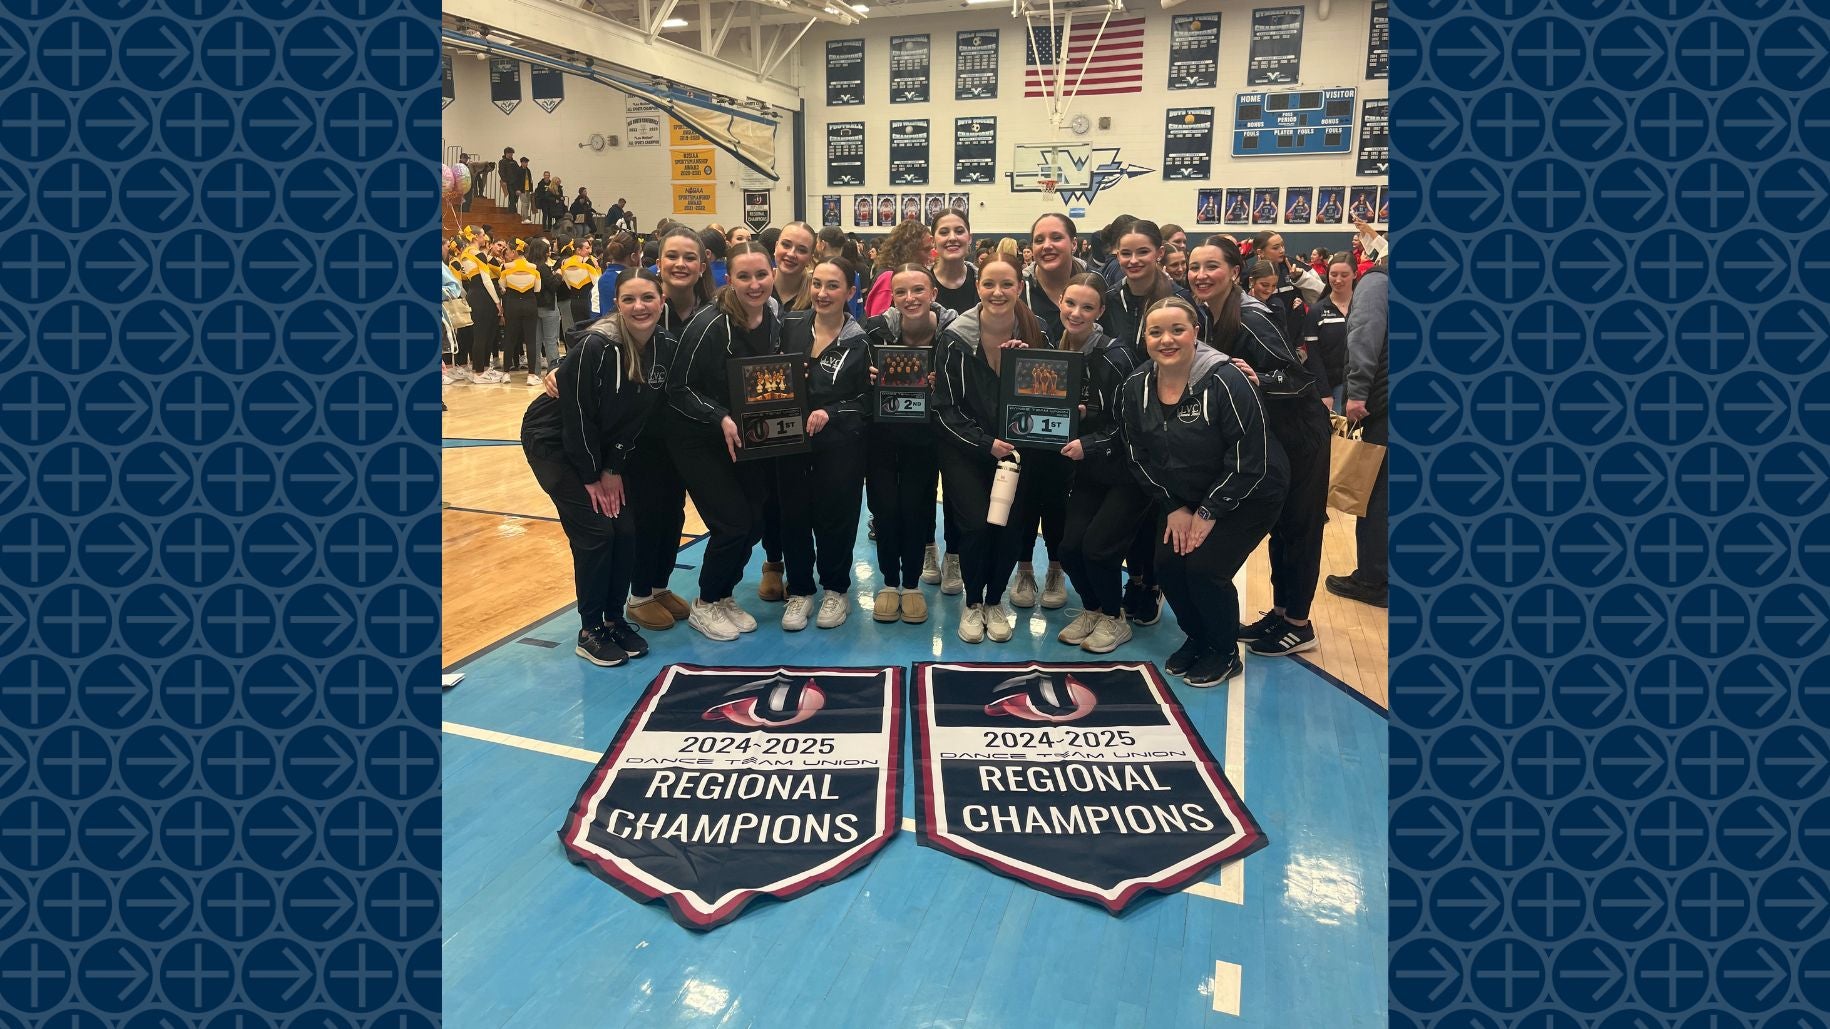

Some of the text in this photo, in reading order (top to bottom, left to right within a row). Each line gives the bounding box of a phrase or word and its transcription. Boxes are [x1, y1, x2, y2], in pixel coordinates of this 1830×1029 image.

[1326, 90, 1354, 99] VISITOR
[904, 400, 922, 410] 2ND
[777, 420, 796, 434] 1ST
[1042, 419, 1061, 432] 1ST
[983, 730, 1136, 748] 2024-2025
[725, 757, 793, 766] TEAM
[645, 770, 839, 800] REGIONAL
[978, 764, 1172, 792] REGIONAL
[606, 808, 859, 844] CHAMPIONS
[962, 804, 1214, 834] CHAMPIONS
